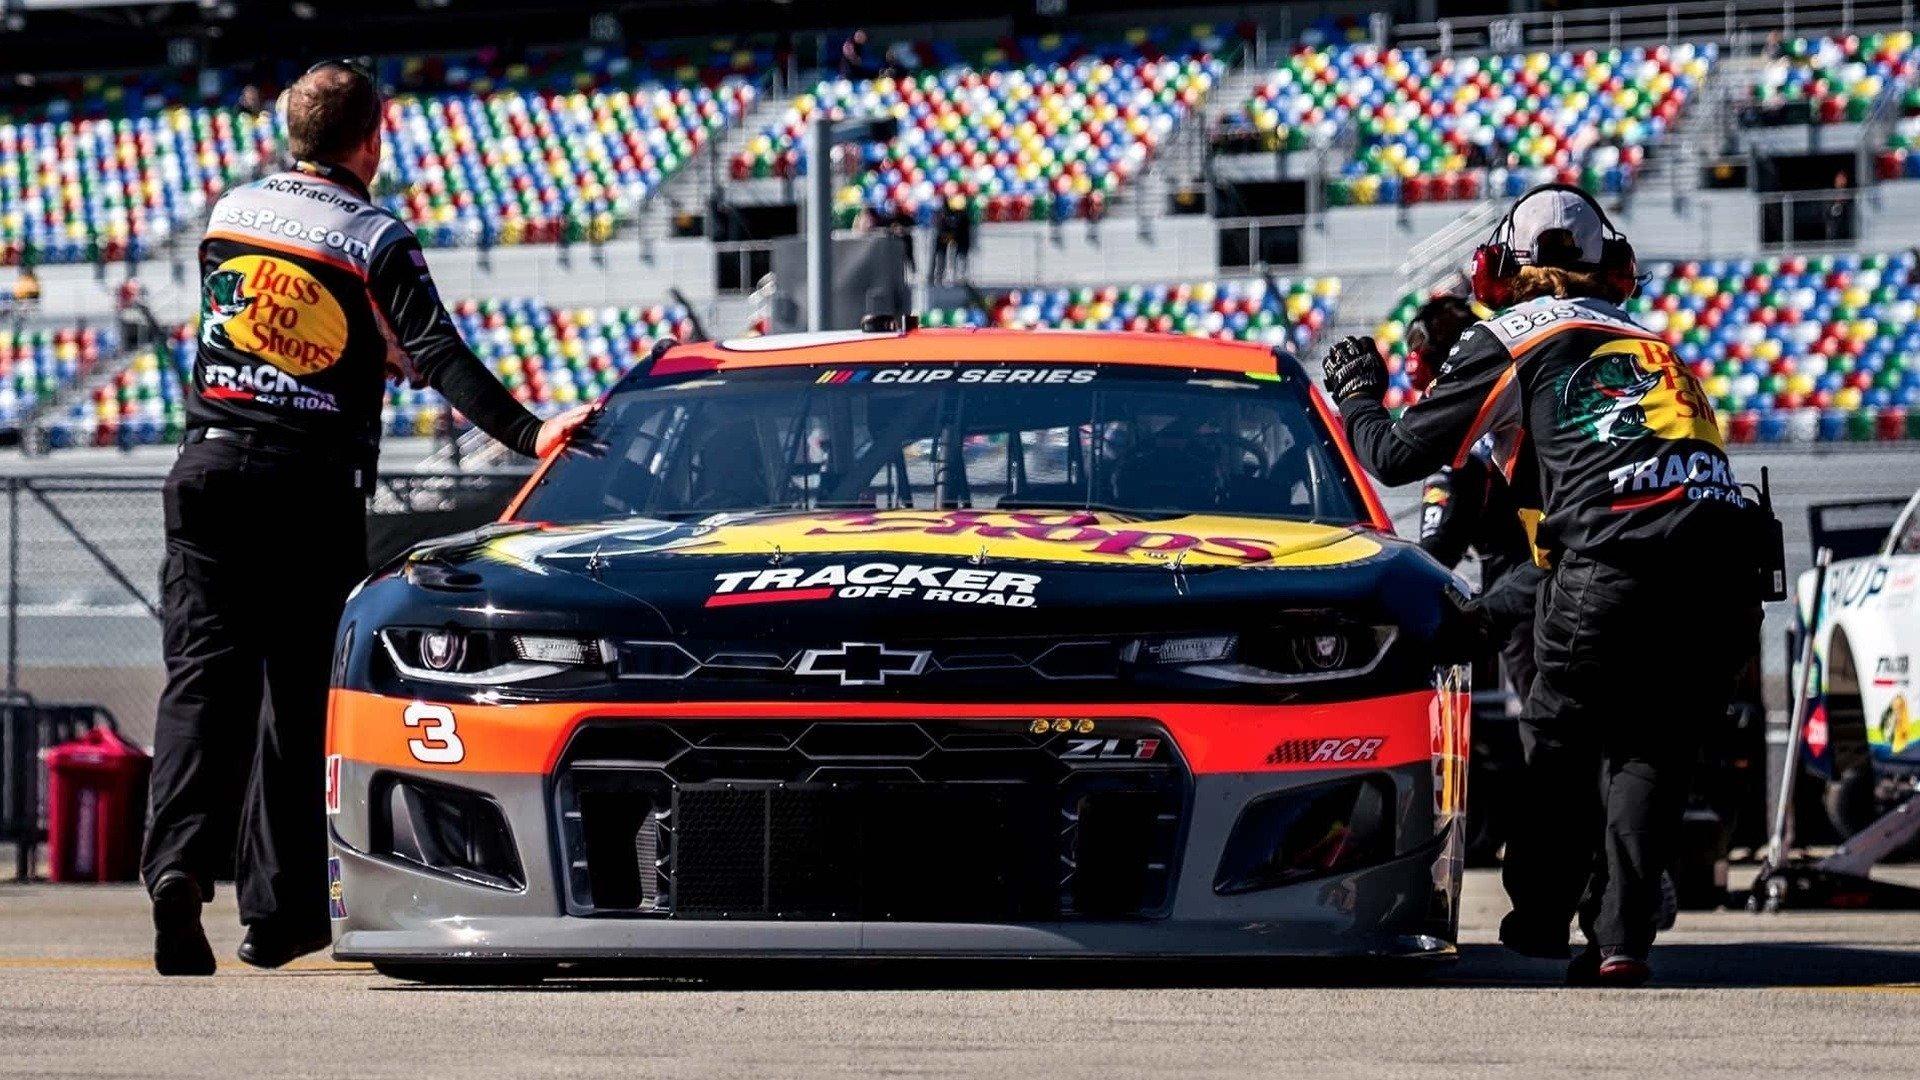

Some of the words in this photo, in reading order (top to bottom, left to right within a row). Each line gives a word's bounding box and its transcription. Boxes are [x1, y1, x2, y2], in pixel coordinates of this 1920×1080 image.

[210, 205, 369, 262] assPro.com
[251, 259, 321, 306] Bass
[249, 292, 299, 330] Pro
[246, 322, 335, 368] Shops
[871, 369, 954, 384] CUP
[957, 369, 1098, 384] SERIES
[714, 562, 1043, 594] TRACKER
[838, 585, 915, 599] OFF
[403, 700, 466, 765] 3
[1058, 739, 1161, 759] ZL1
[1308, 738, 1384, 762] RCR
